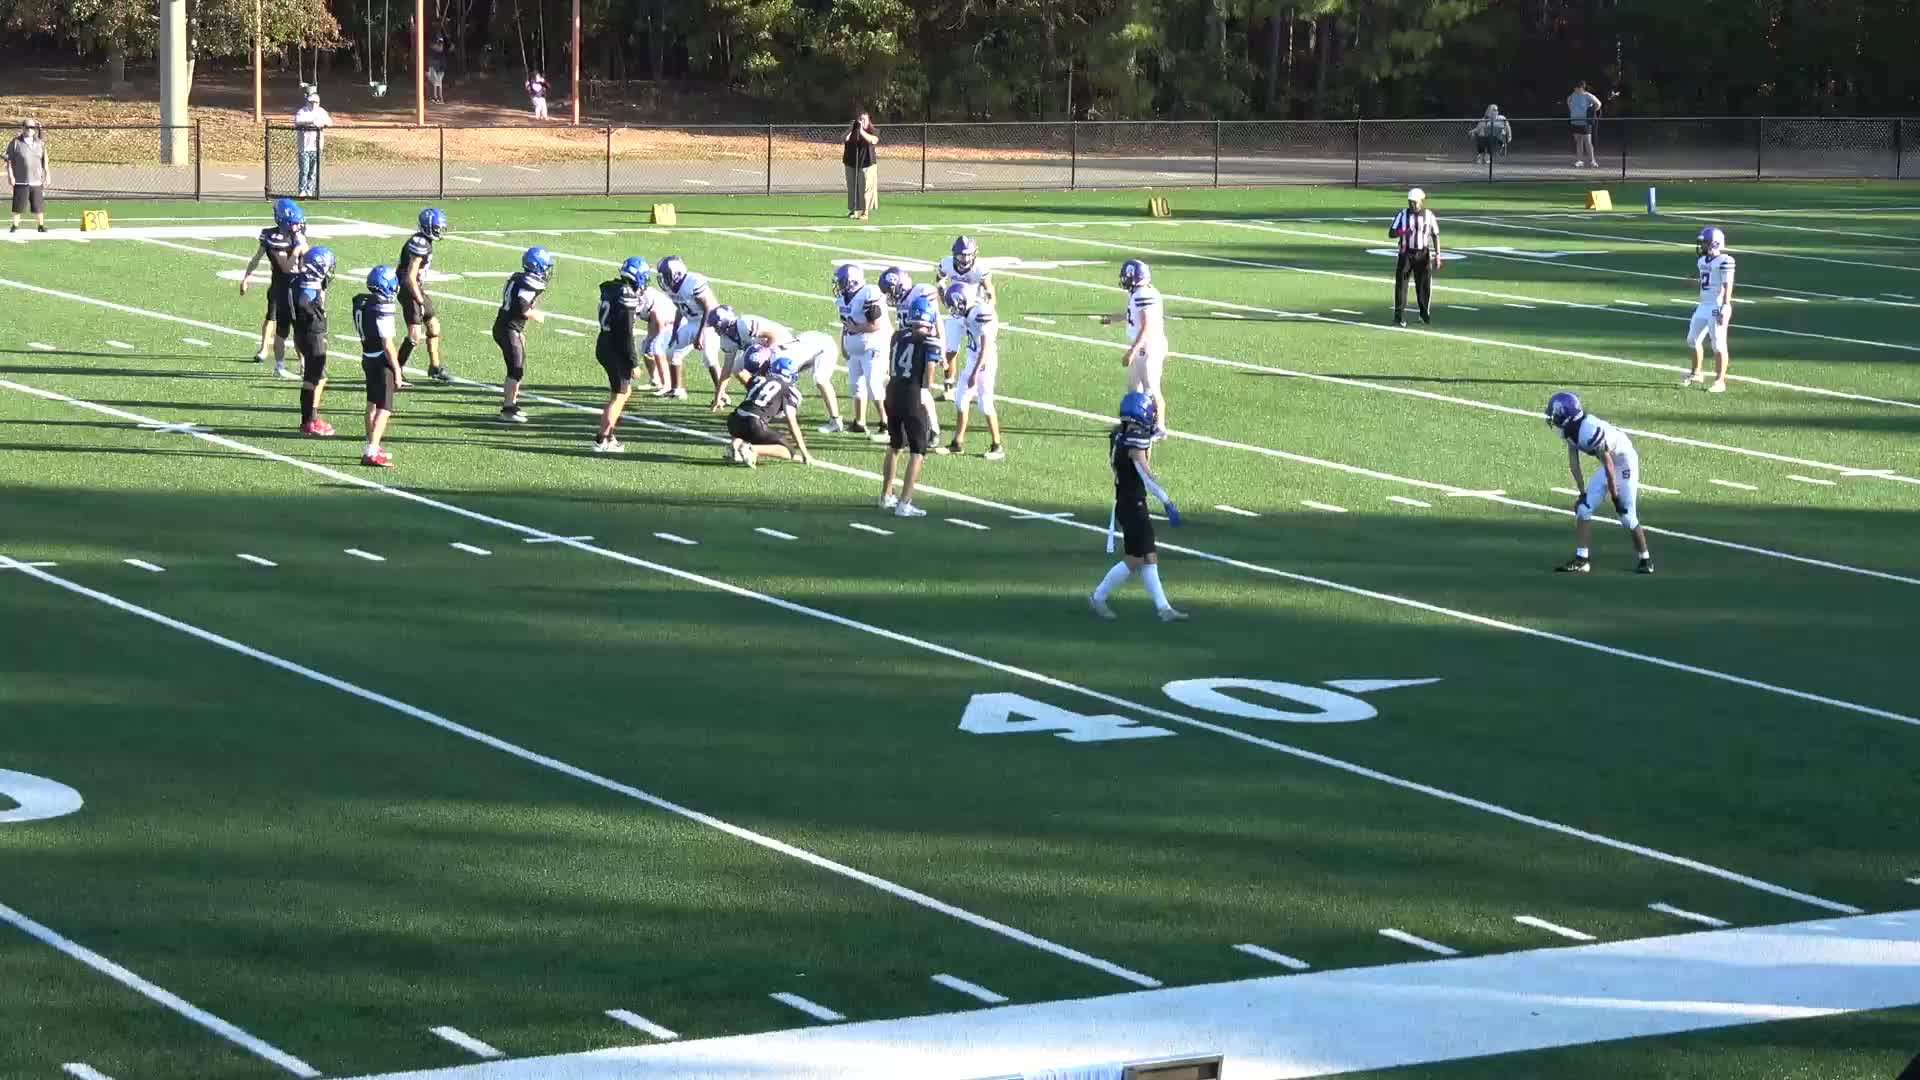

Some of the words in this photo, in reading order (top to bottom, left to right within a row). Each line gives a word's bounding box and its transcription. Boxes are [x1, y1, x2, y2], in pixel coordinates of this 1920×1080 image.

[86, 211, 107, 230] 30
[890, 342, 915, 378] 14
[958, 678, 1378, 742] 40
